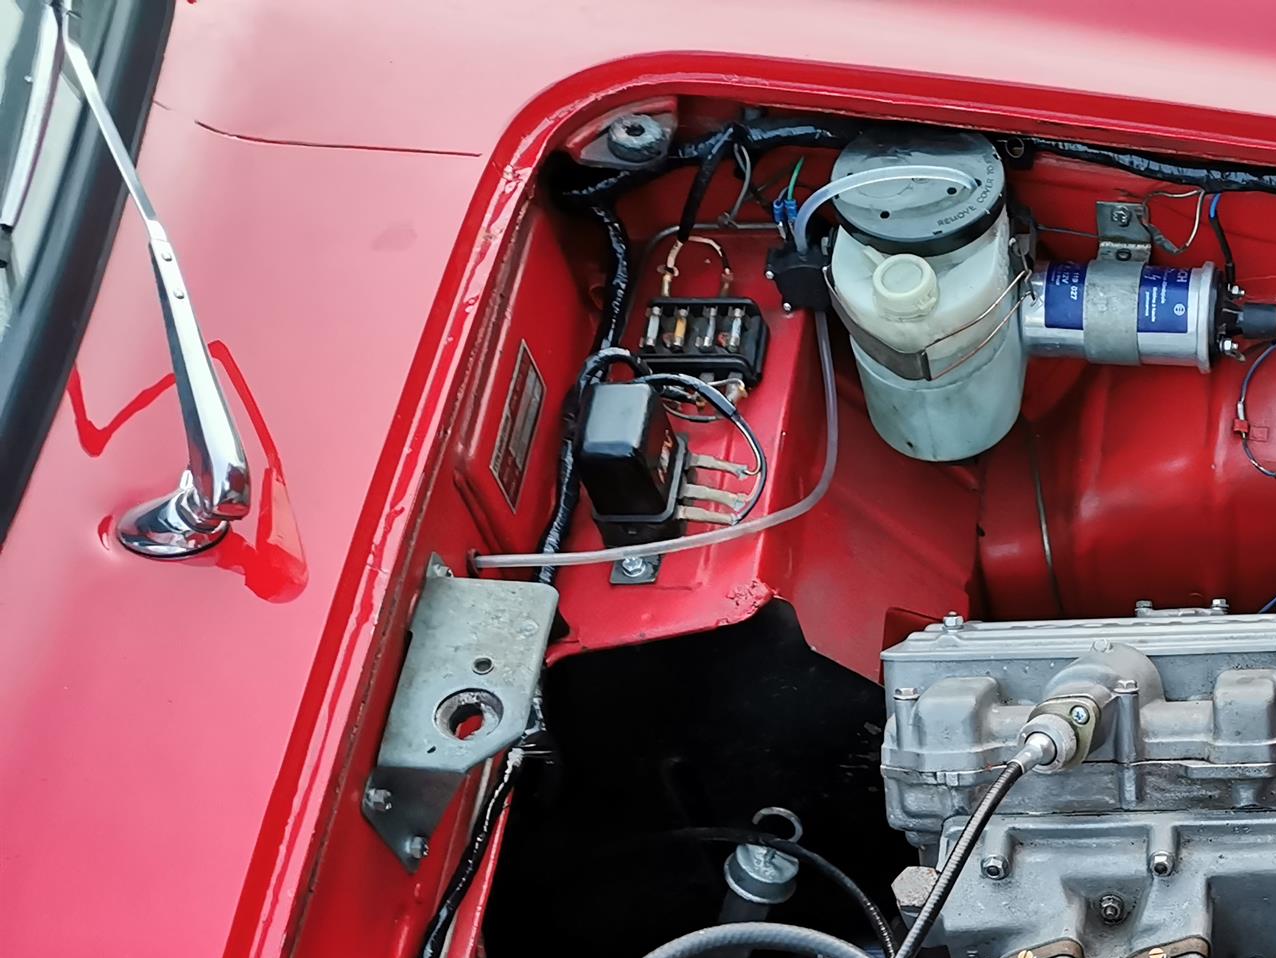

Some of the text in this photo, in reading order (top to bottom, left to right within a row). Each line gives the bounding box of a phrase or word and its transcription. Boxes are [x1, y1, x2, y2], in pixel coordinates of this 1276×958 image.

[937, 206, 977, 227] REMOVE
[976, 178, 995, 203] COVER
[1070, 285, 1079, 301] 027
